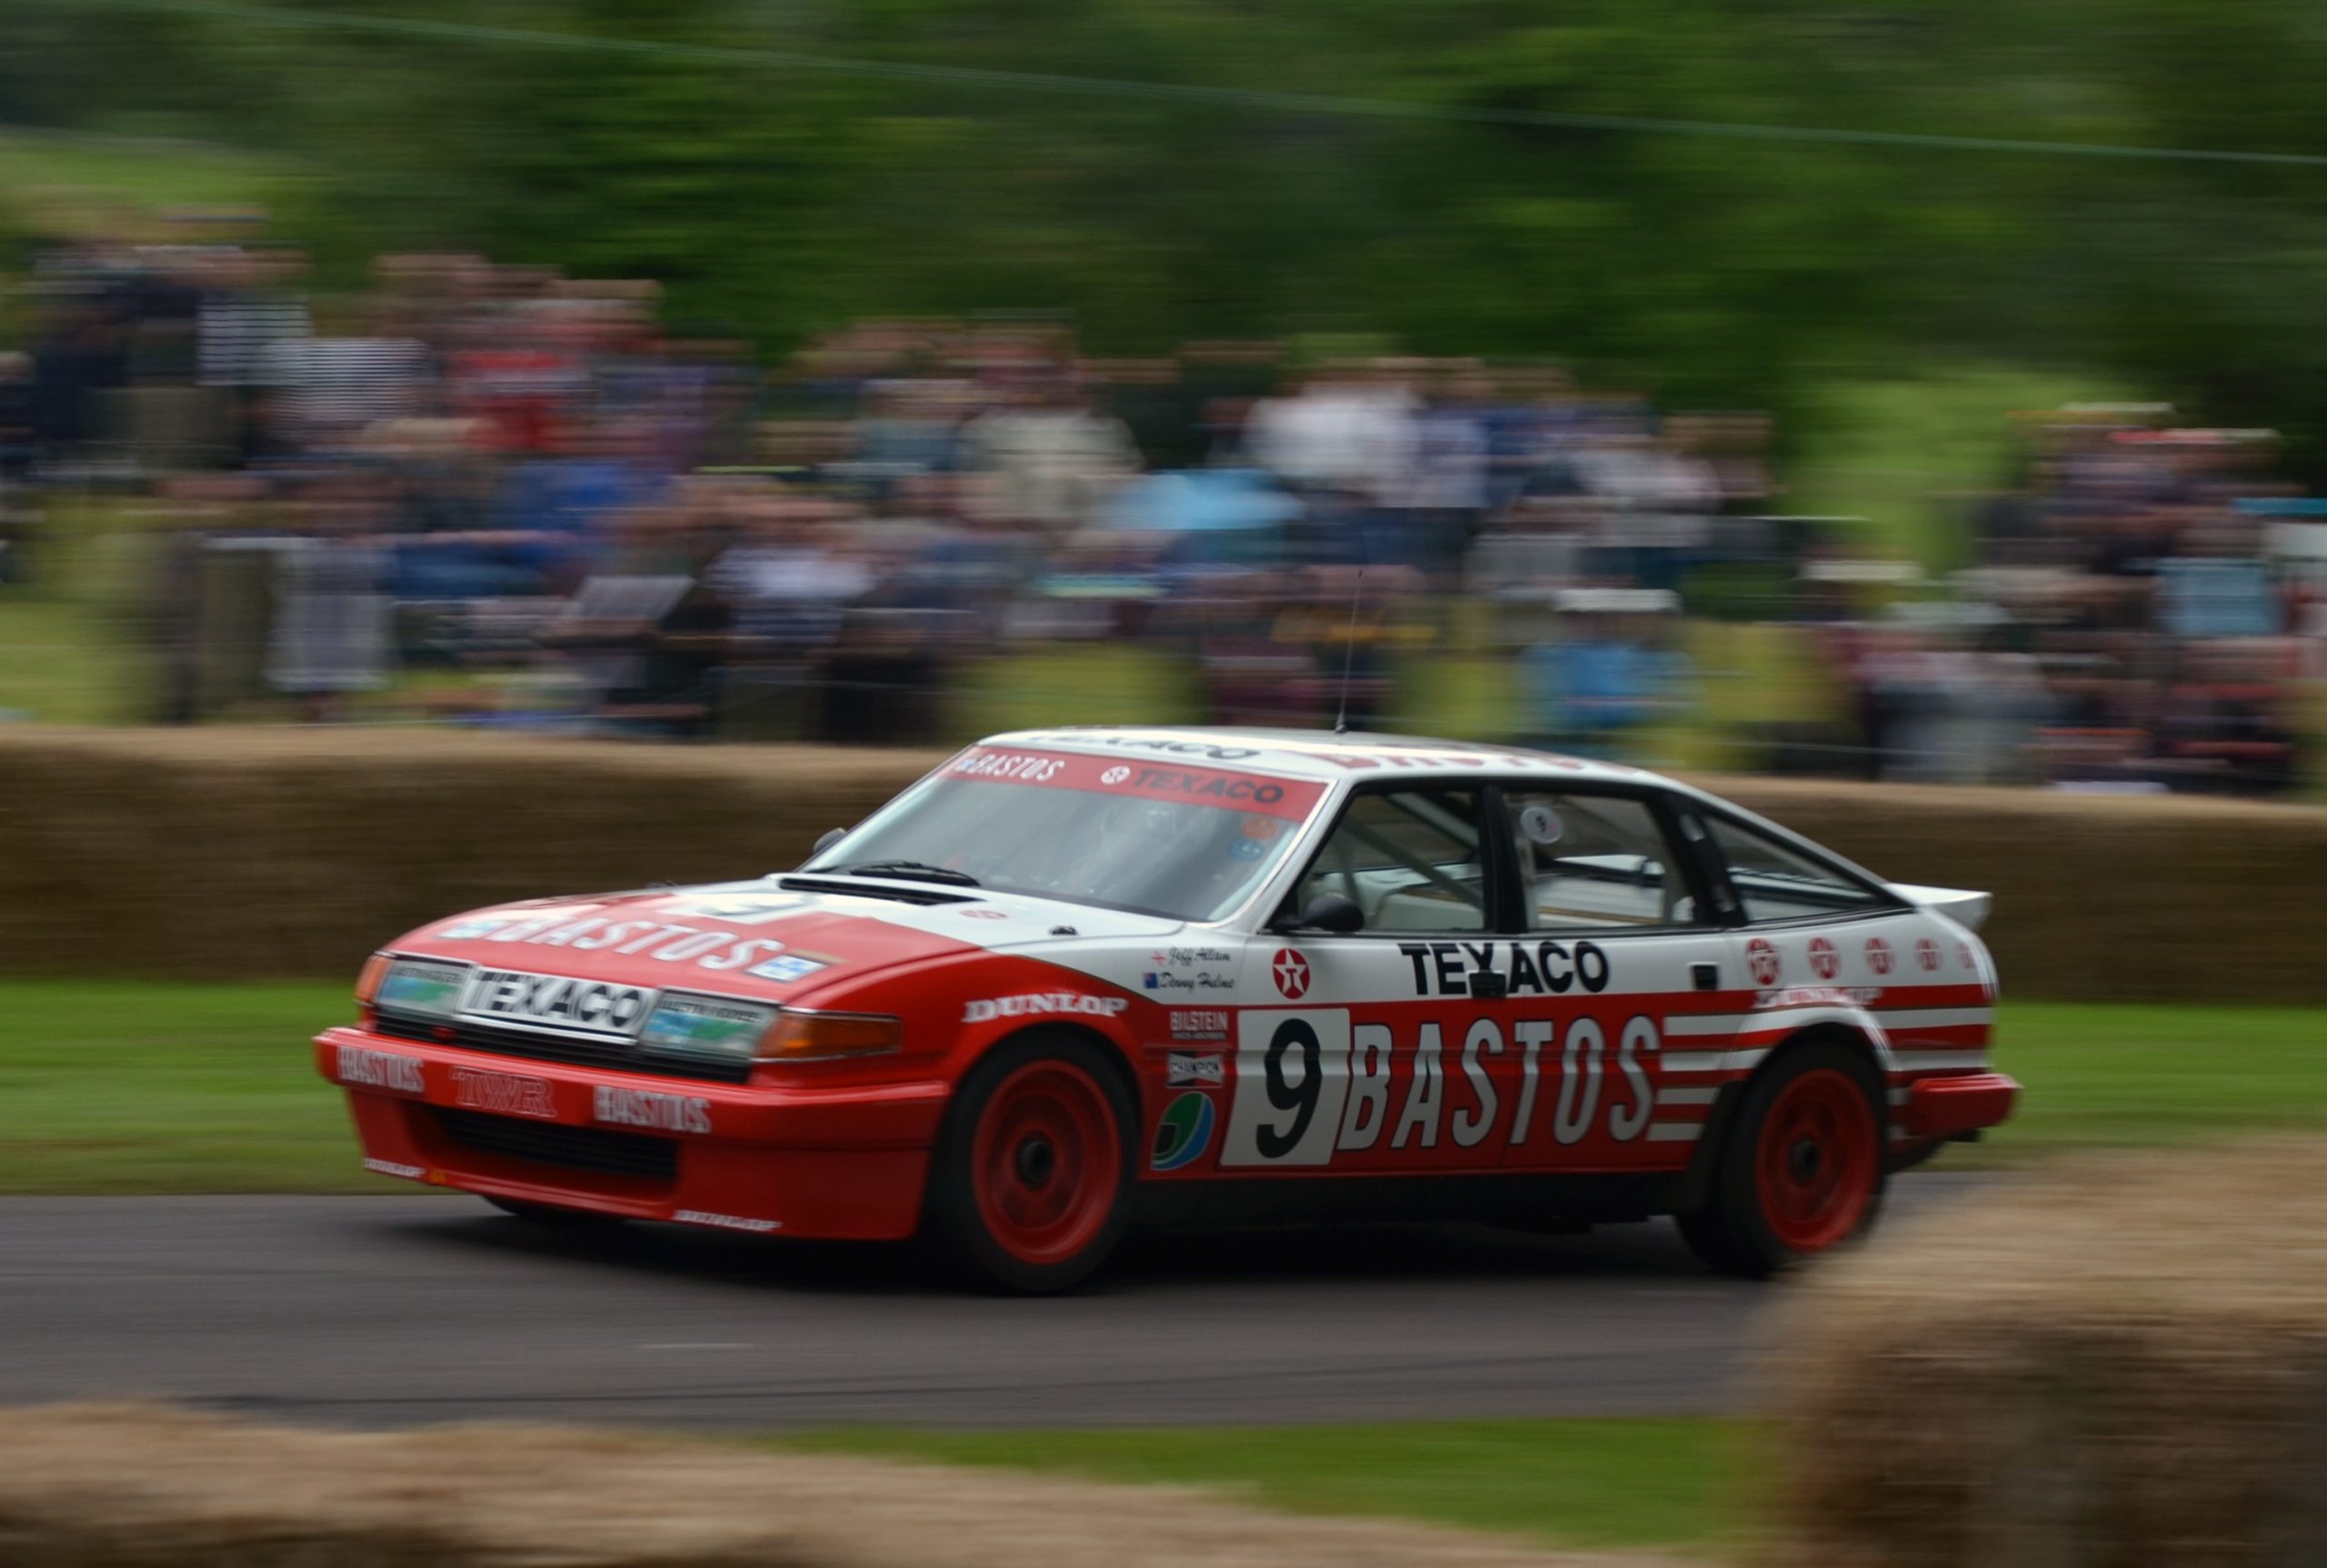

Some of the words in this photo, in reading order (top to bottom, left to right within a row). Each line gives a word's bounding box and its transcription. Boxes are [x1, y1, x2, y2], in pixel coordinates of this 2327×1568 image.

[968, 754, 1065, 782] BASTOS
[1132, 767, 1284, 804] TEXACO
[484, 914, 786, 970] BASTOS
[1399, 942, 1609, 996] TEXACO
[464, 970, 645, 1028] TEXACO
[963, 993, 1128, 1024] DUNLOP
[1170, 1011, 1228, 1031] BILSTEIN
[337, 1045, 425, 1093] BASTOS
[1256, 1018, 1323, 1159] 9
[1336, 1014, 1660, 1151] BASTOS
[594, 1084, 712, 1134] BASTOS
